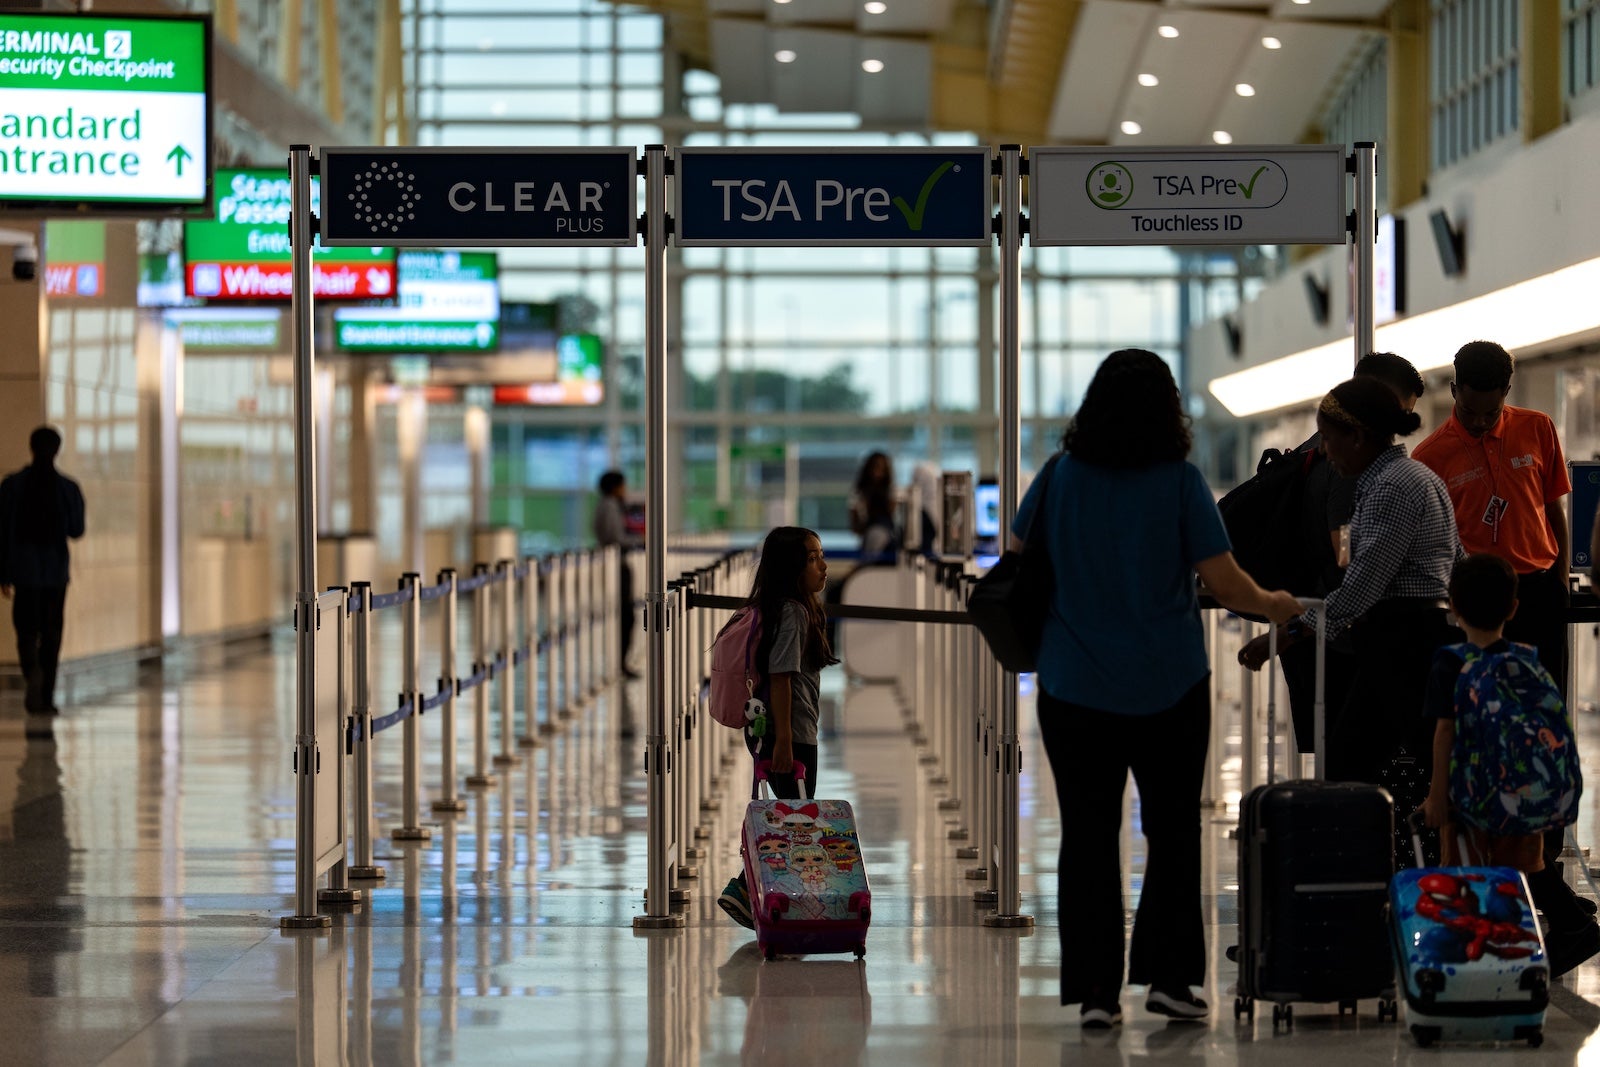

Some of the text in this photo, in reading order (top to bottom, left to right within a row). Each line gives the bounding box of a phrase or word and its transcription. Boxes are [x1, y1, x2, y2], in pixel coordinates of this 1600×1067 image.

[69, 57, 176, 82] Checkpoint
[1, 107, 141, 141] andard
[448, 182, 604, 212] CLEAR
[1153, 175, 1237, 196] TSA Pre
[711, 179, 890, 222] TSA Pre
[556, 217, 604, 233] PLUS
[1131, 214, 1243, 232] Touchless ID
[223, 265, 358, 295] Wheehair
